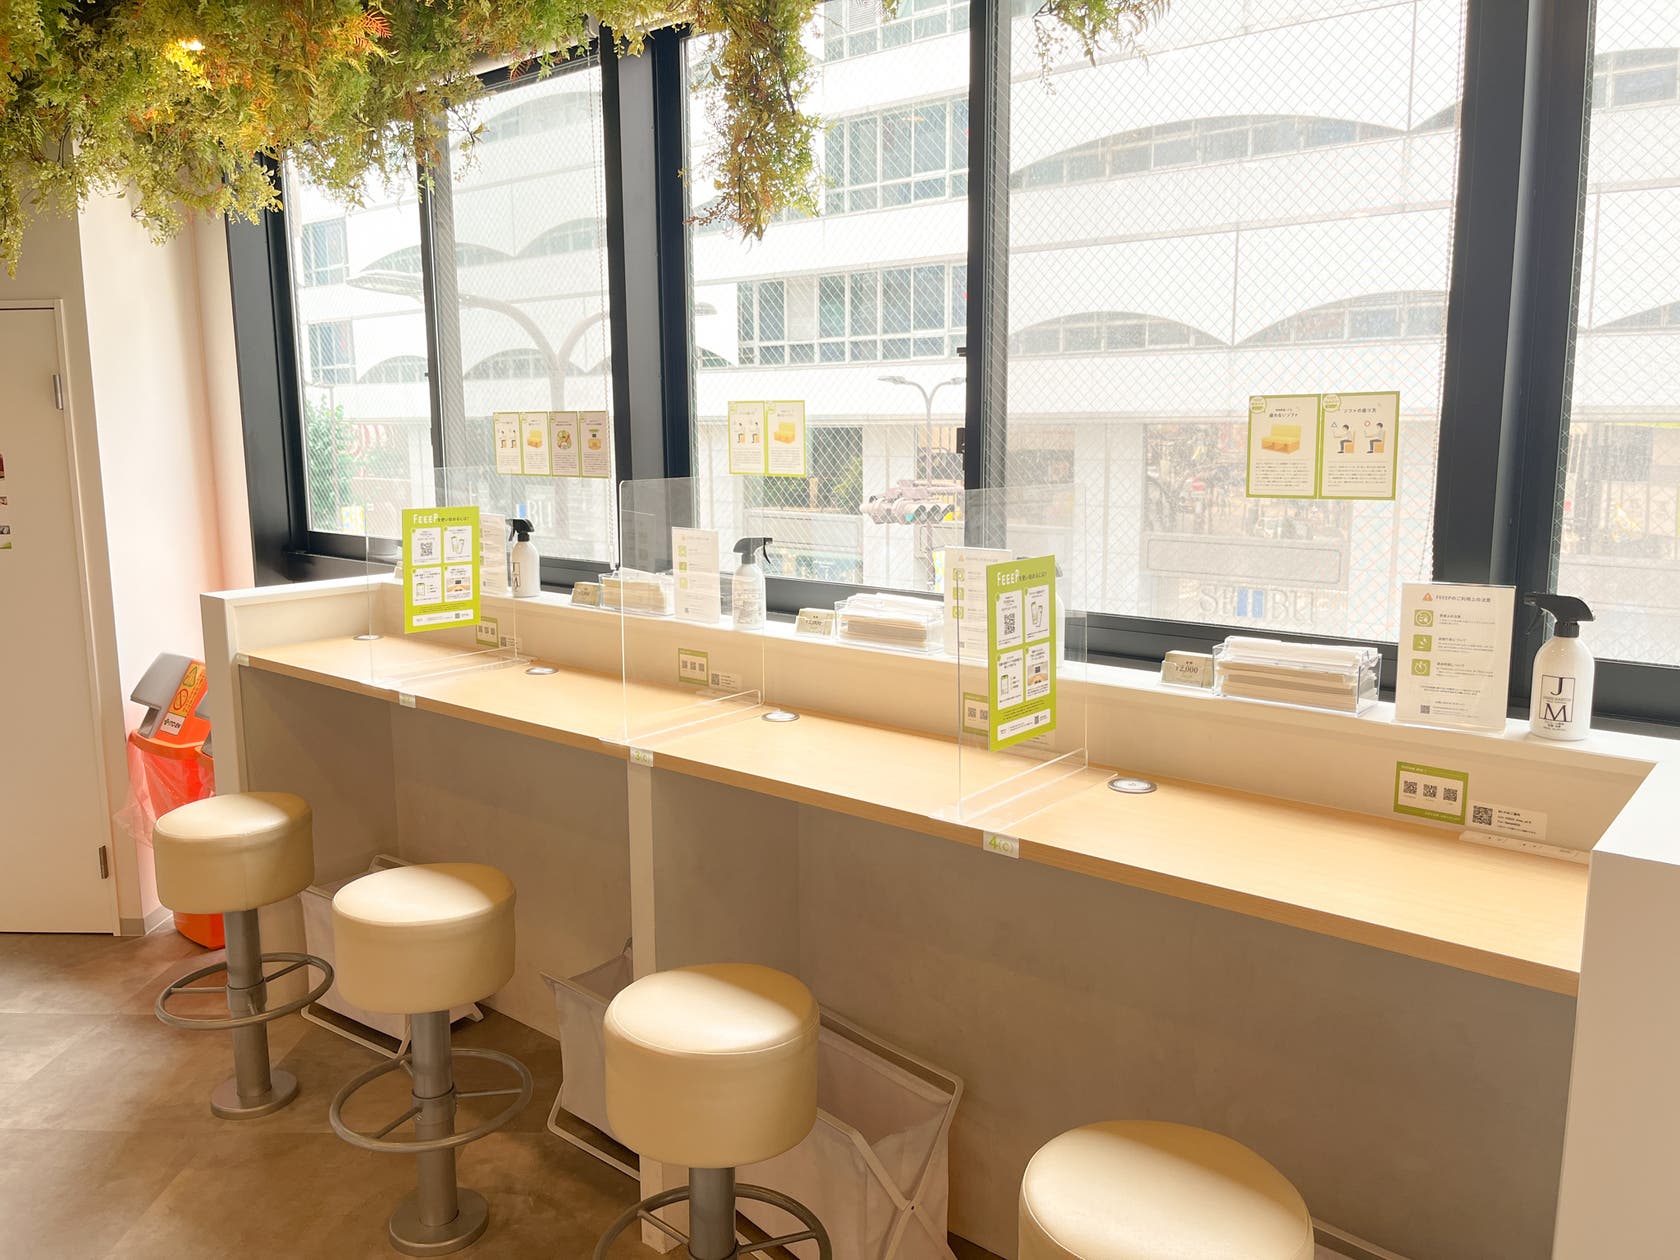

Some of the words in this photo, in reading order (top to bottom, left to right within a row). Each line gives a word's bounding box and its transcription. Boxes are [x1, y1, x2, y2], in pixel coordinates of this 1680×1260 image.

[997, 569, 1019, 587] FEEEP
[1550, 676, 1564, 696] J
[1544, 702, 1567, 723] M
